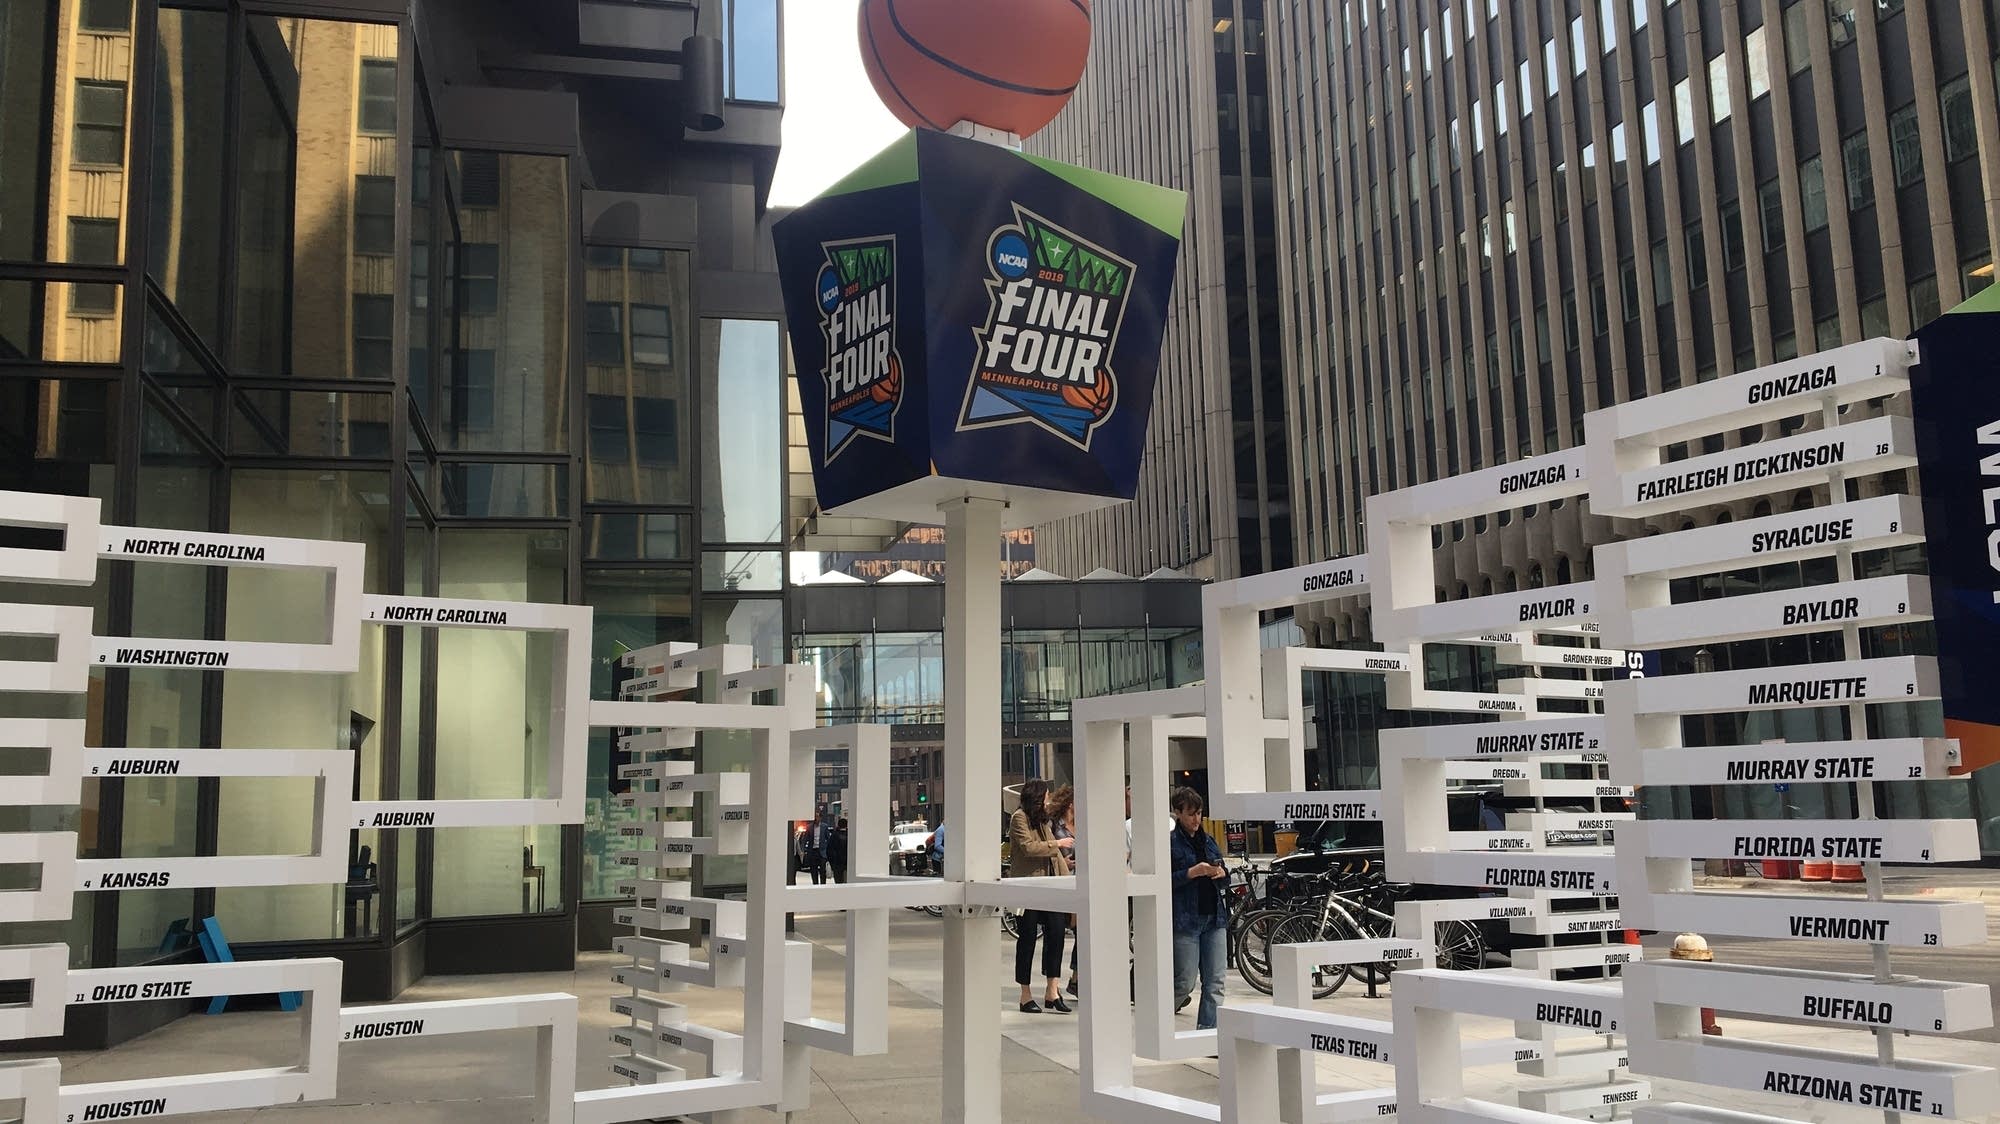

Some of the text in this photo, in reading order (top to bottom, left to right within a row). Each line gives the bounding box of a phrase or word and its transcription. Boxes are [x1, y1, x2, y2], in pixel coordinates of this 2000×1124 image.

[998, 252, 1028, 268] NCAA
[1038, 269, 1064, 282] 2019
[822, 285, 838, 302] NCAA
[844, 282, 860, 298] 2019
[997, 277, 1110, 338] FINAL
[829, 283, 890, 354] FINAL
[984, 324, 1102, 384] FOUR
[829, 329, 890, 400] FOUR
[981, 371, 1058, 392] MINNEAPOLIS
[1748, 364, 1882, 404] GONZAGA 1
[830, 388, 870, 412] MINNEAPOLIS
[1499, 464, 1580, 494] GONZAGA 1
[1637, 441, 1888, 502] FAIRLEIGH DICKINSON 16
[1751, 518, 1898, 552] SYRACUSE 8
[122, 538, 180, 556] NORTH
[183, 542, 266, 562] CAROLINA
[1303, 569, 1364, 592] GONZAGA 1
[383, 606, 432, 622] NORTH
[436, 608, 508, 626] CAROLINA
[1519, 597, 1590, 622] BAYLOR 9
[1782, 597, 1906, 626] BAYLOR 9
[1580, 623, 1600, 632] VIRGI
[98, 648, 228, 666] 9 WASHINGTON
[1364, 658, 1400, 670] VIRGINIA
[1563, 653, 1612, 666] GARDNER-WEBB
[1584, 687, 1596, 696] OLE
[1748, 676, 1914, 704] MARQUETTE 5
[1478, 699, 1516, 710] OKLAHOMA
[1476, 731, 1598, 754] MURRAY STATE 12
[91, 759, 180, 776] 5 AUBURN
[1581, 753, 1608, 762] WISCON
[1492, 768, 1520, 778] OREGON
[1726, 756, 1922, 780] MURRAY STATE 12
[1595, 786, 1622, 796] OREGON
[358, 810, 434, 828] 5 AUBURN
[1284, 803, 1376, 818] FLORIDA STATE 4
[1578, 819, 1616, 828] KANSAS ST
[1488, 839, 1498, 848] UC
[1500, 838, 1524, 848] IRVINE
[1733, 836, 1930, 860] FLORIDA STATE 4
[83, 871, 170, 888] 4 KANSAS
[1485, 868, 1610, 890] FLORIDA STATE 4
[1489, 906, 1526, 918] VILLANOVA
[1567, 920, 1588, 932] SAINT
[1588, 920, 1612, 930] MARY'S
[1789, 916, 1938, 946] VERMONT 13
[1382, 948, 1414, 960] PURDUE
[1604, 953, 1630, 964] PURDUE
[75, 980, 192, 1002] 11 OHIO STATE
[1536, 1002, 1616, 1030] BUFFALO 6
[1803, 995, 1942, 1030] BUFFALO 6
[343, 1018, 424, 1040] 3 HOUSTON
[1310, 1034, 1388, 1062] TEXAS TECH 3
[1514, 1049, 1534, 1060] IOWA
[1618, 1057, 1630, 1068] IO
[1602, 1090, 1638, 1104] TENNESSEE
[1763, 1070, 1944, 1116] ARIZONA STATE 11
[66, 1097, 166, 1122] 3 HOUSTON
[1377, 1103, 1398, 1116] TENN
